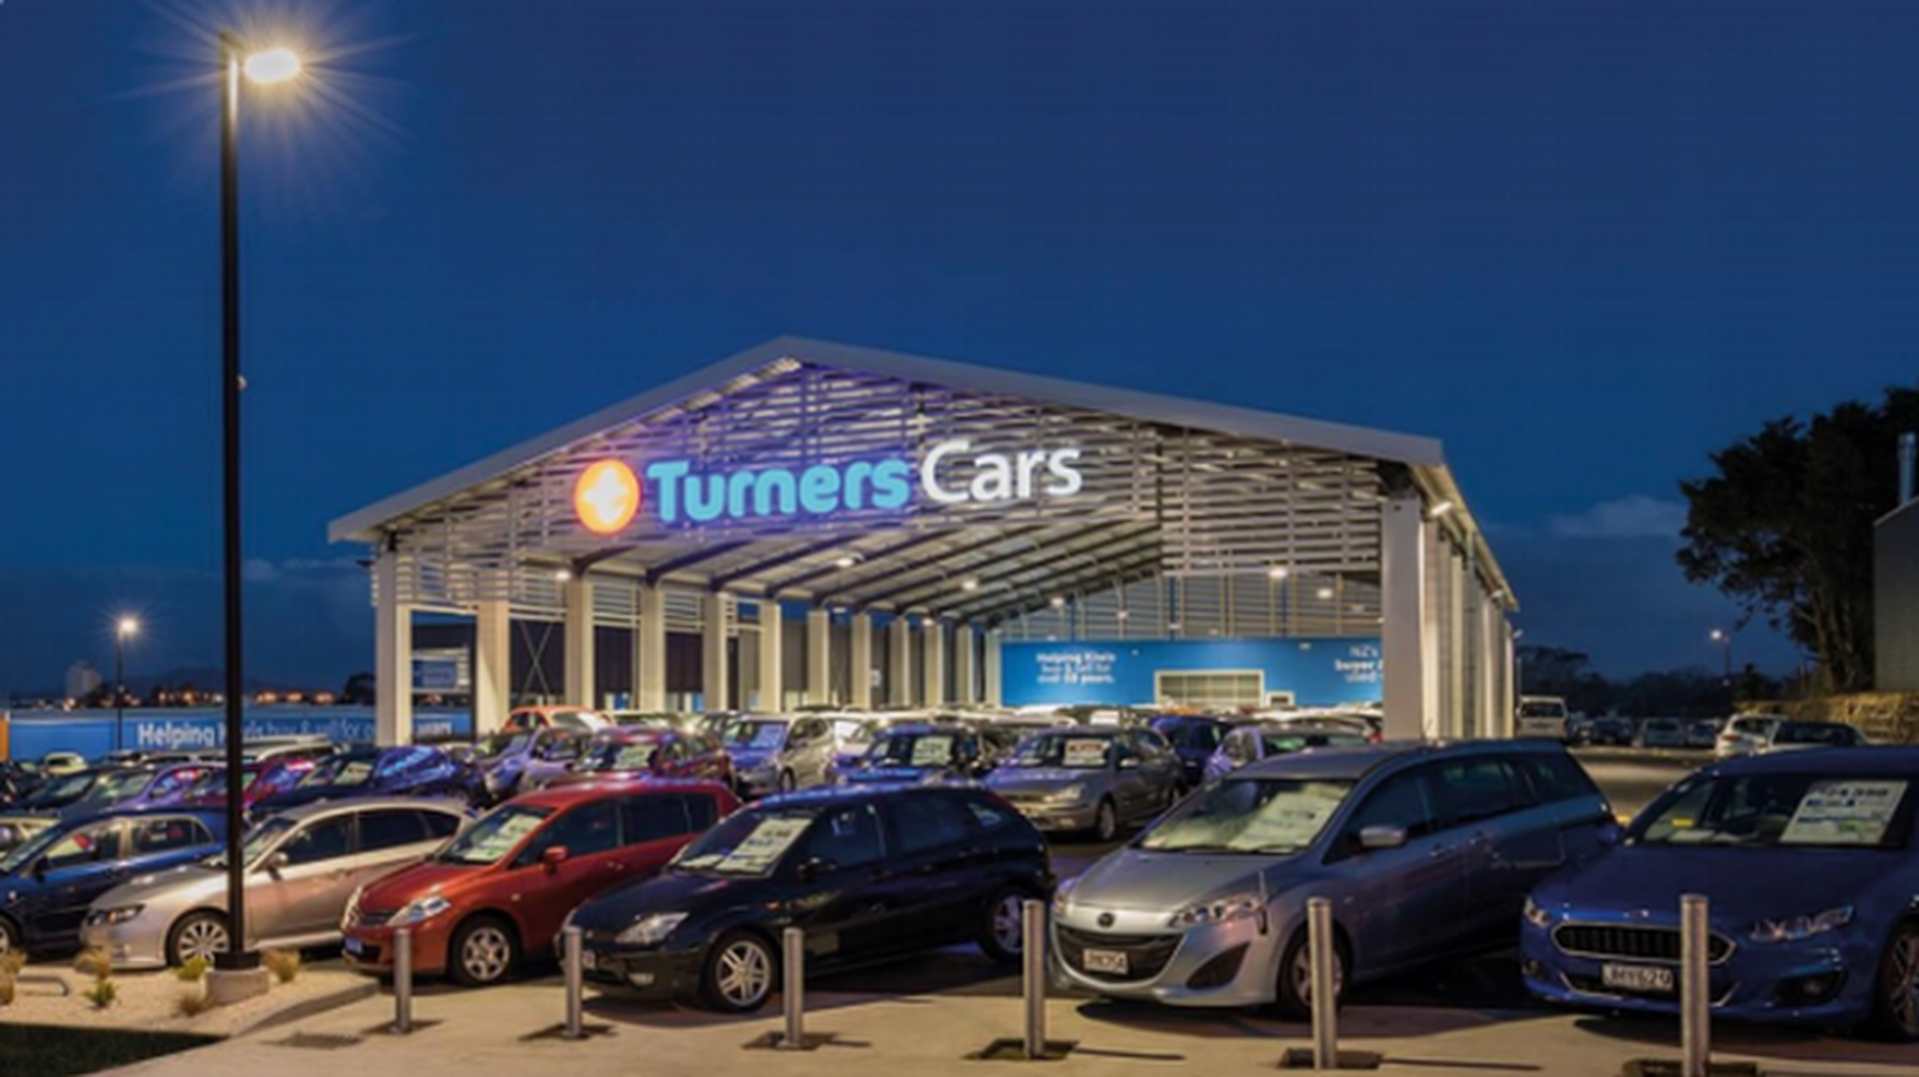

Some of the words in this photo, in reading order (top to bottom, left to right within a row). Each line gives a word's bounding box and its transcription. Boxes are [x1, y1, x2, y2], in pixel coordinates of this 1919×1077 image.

[647, 459, 911, 522] Turners
[921, 440, 1083, 502] Cars
[137, 722, 215, 747] Helping
